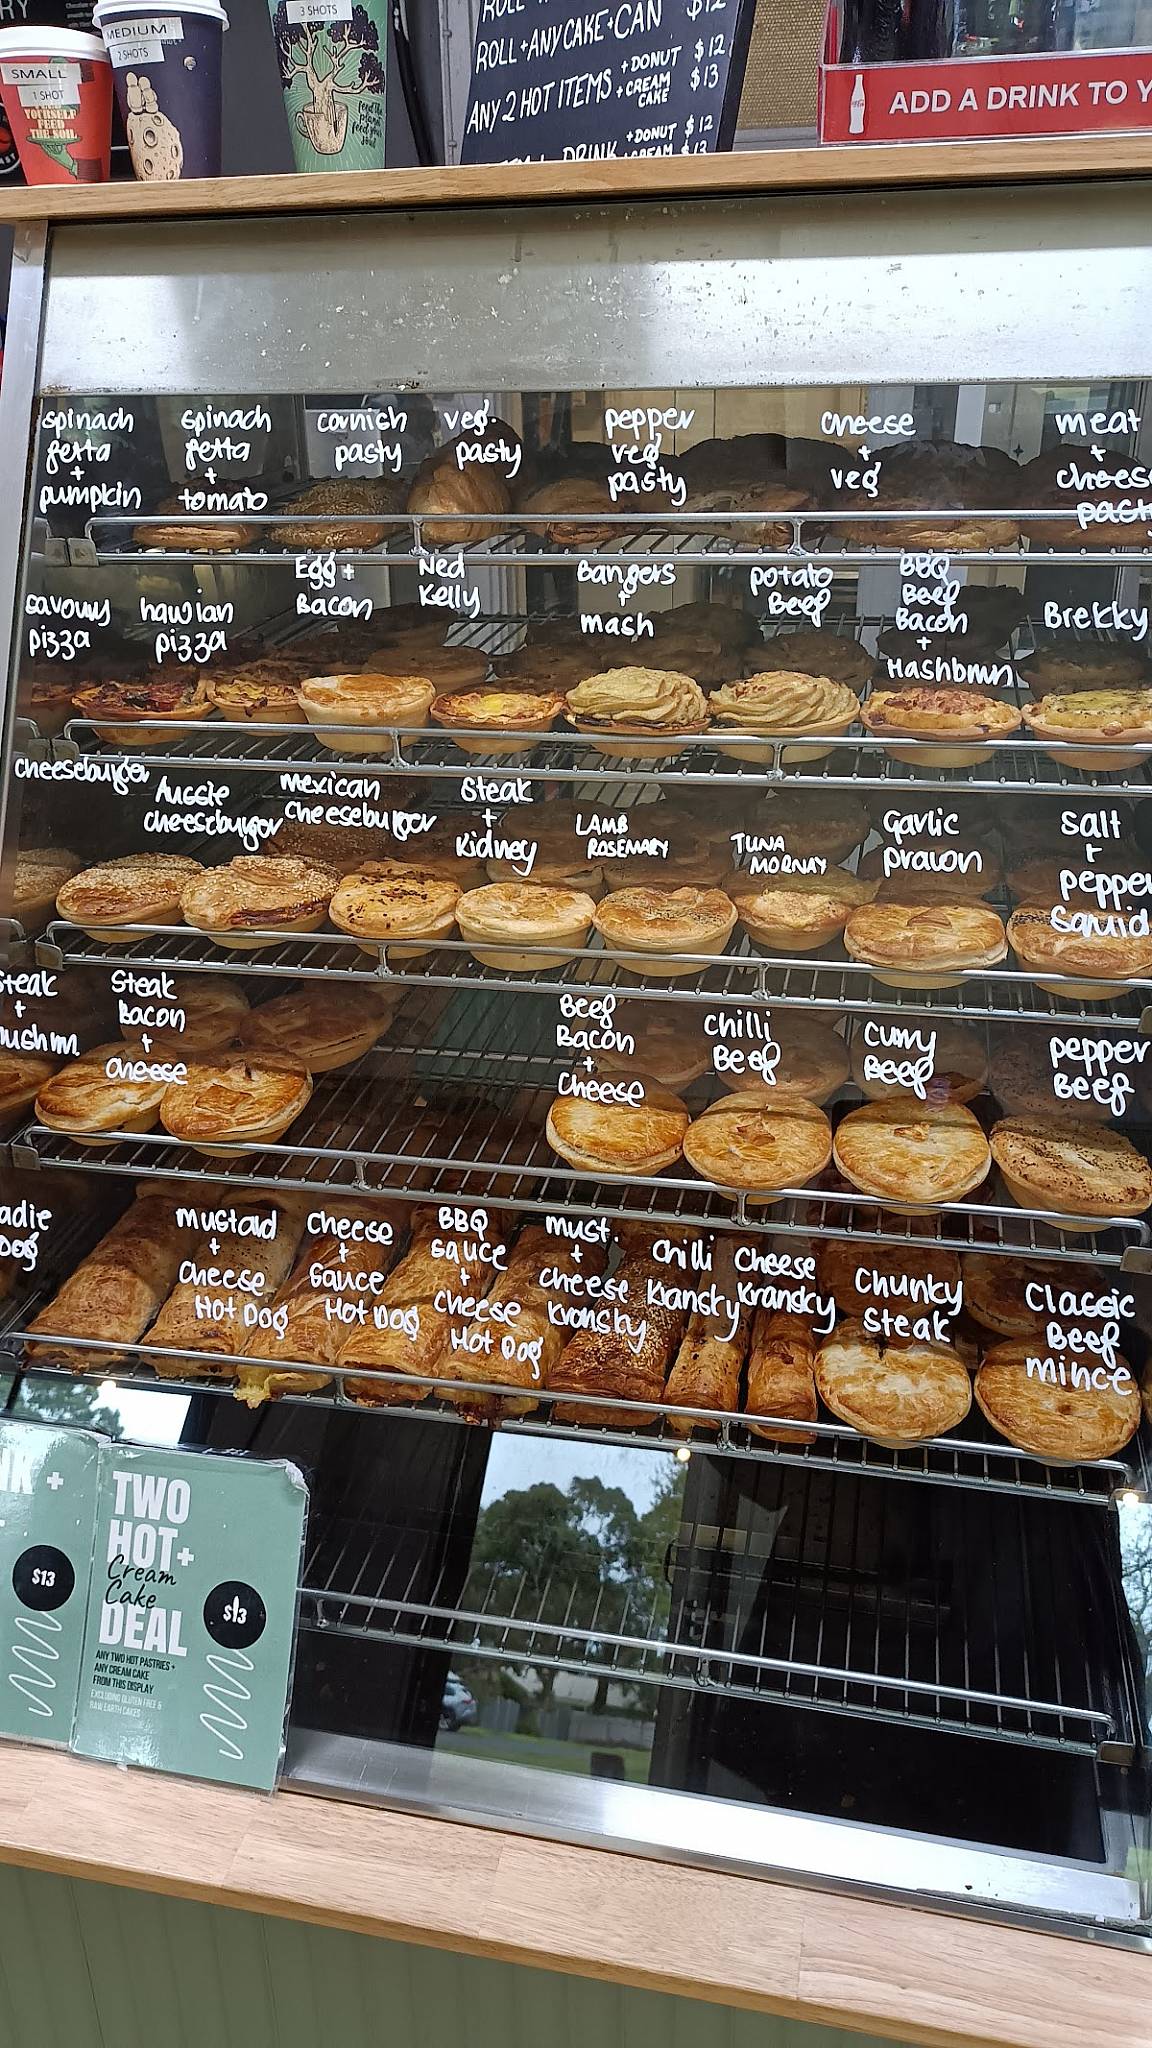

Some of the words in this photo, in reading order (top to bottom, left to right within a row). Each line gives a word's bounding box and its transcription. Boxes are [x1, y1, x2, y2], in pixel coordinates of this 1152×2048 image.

[300, 6, 305, 16] 3
[308, 5, 338, 16] SHOTS
[106, 24, 167, 40] MEDIUM
[476, 38, 517, 74] ROLL
[563, 8, 609, 50] CAKE
[117, 52, 123, 61] 2
[122, 47, 149, 59] SHOTS
[12, 69, 67, 79] SMALL
[33, 91, 38, 100] 1
[40, 90, 64, 100] SHOT
[466, 99, 501, 134] ANY
[502, 90, 517, 121] 2
[520, 81, 555, 118] HOT
[558, 68, 612, 109] ITEMS
[637, 87, 670, 108] CAKE
[889, 88, 952, 115] ADD
[957, 87, 979, 112] A
[987, 82, 1080, 111] DRINK
[1088, 80, 1128, 106] TO
[24, 109, 77, 119] YOURSELF
[38, 119, 65, 129] FEED
[30, 129, 50, 139] THE
[42, 408, 134, 439] spinach
[181, 405, 272, 441] spinach
[605, 408, 695, 441] pepper
[46, 438, 111, 475] fetta
[185, 437, 252, 472] fetta
[334, 440, 402, 472] pasty
[456, 438, 522, 479] pasty
[611, 432, 662, 469] veg
[608, 468, 687, 506] pasty
[830, 462, 882, 498] veg
[40, 481, 142, 514] pumpkin
[178, 487, 268, 512] tomato
[295, 552, 336, 591] Egg
[419, 552, 465, 579] Ned
[577, 563, 676, 595] Bangers
[750, 565, 834, 596] potato
[900, 553, 951, 587] BBQ
[296, 592, 373, 621] Bacon
[767, 591, 832, 628] Beef
[902, 580, 961, 618] Beef
[896, 607, 969, 634] Bacon
[1044, 600, 1149, 641] Brekky
[29, 624, 91, 661] pizza
[156, 628, 228, 664] pizza
[576, 813, 629, 836] LAMB
[587, 837, 669, 859] ROSEMARY
[730, 832, 785, 854] TUNA
[750, 855, 828, 875] MORNAY
[559, 994, 617, 1029] Beef
[556, 1024, 635, 1055] Bacon
[1049, 1036, 1151, 1077] pepper
[712, 1041, 782, 1086] Beef
[864, 1055, 934, 1100] Beef
[1053, 1072, 1136, 1117] Beef
[438, 1206, 489, 1241] BBQ
[855, 1267, 963, 1316] Chunky
[1025, 1282, 1136, 1320] Classic
[244, 1302, 289, 1340] Dog
[374, 1305, 420, 1342] Dog
[501, 1335, 544, 1381] Dog
[1046, 1322, 1121, 1368] Beef
[112, 1470, 192, 1524] TWO
[32, 1568, 57, 1588] $13
[107, 1554, 177, 1586] Cream
[105, 1580, 157, 1609] Cake
[99, 1602, 188, 1657] DEAL
[94, 1662, 109, 1673] ANY
[109, 1665, 132, 1677] CREAM
[132, 1668, 150, 1680] CAKE
[95, 1649, 109, 1661] ANY
[111, 1652, 126, 1663] TWO
[126, 1655, 139, 1666] HOT
[139, 1656, 171, 1671] PASTRIES
[92, 1675, 111, 1687] FROM
[112, 1677, 126, 1690] THIS
[126, 1680, 154, 1694] DISPLAY
